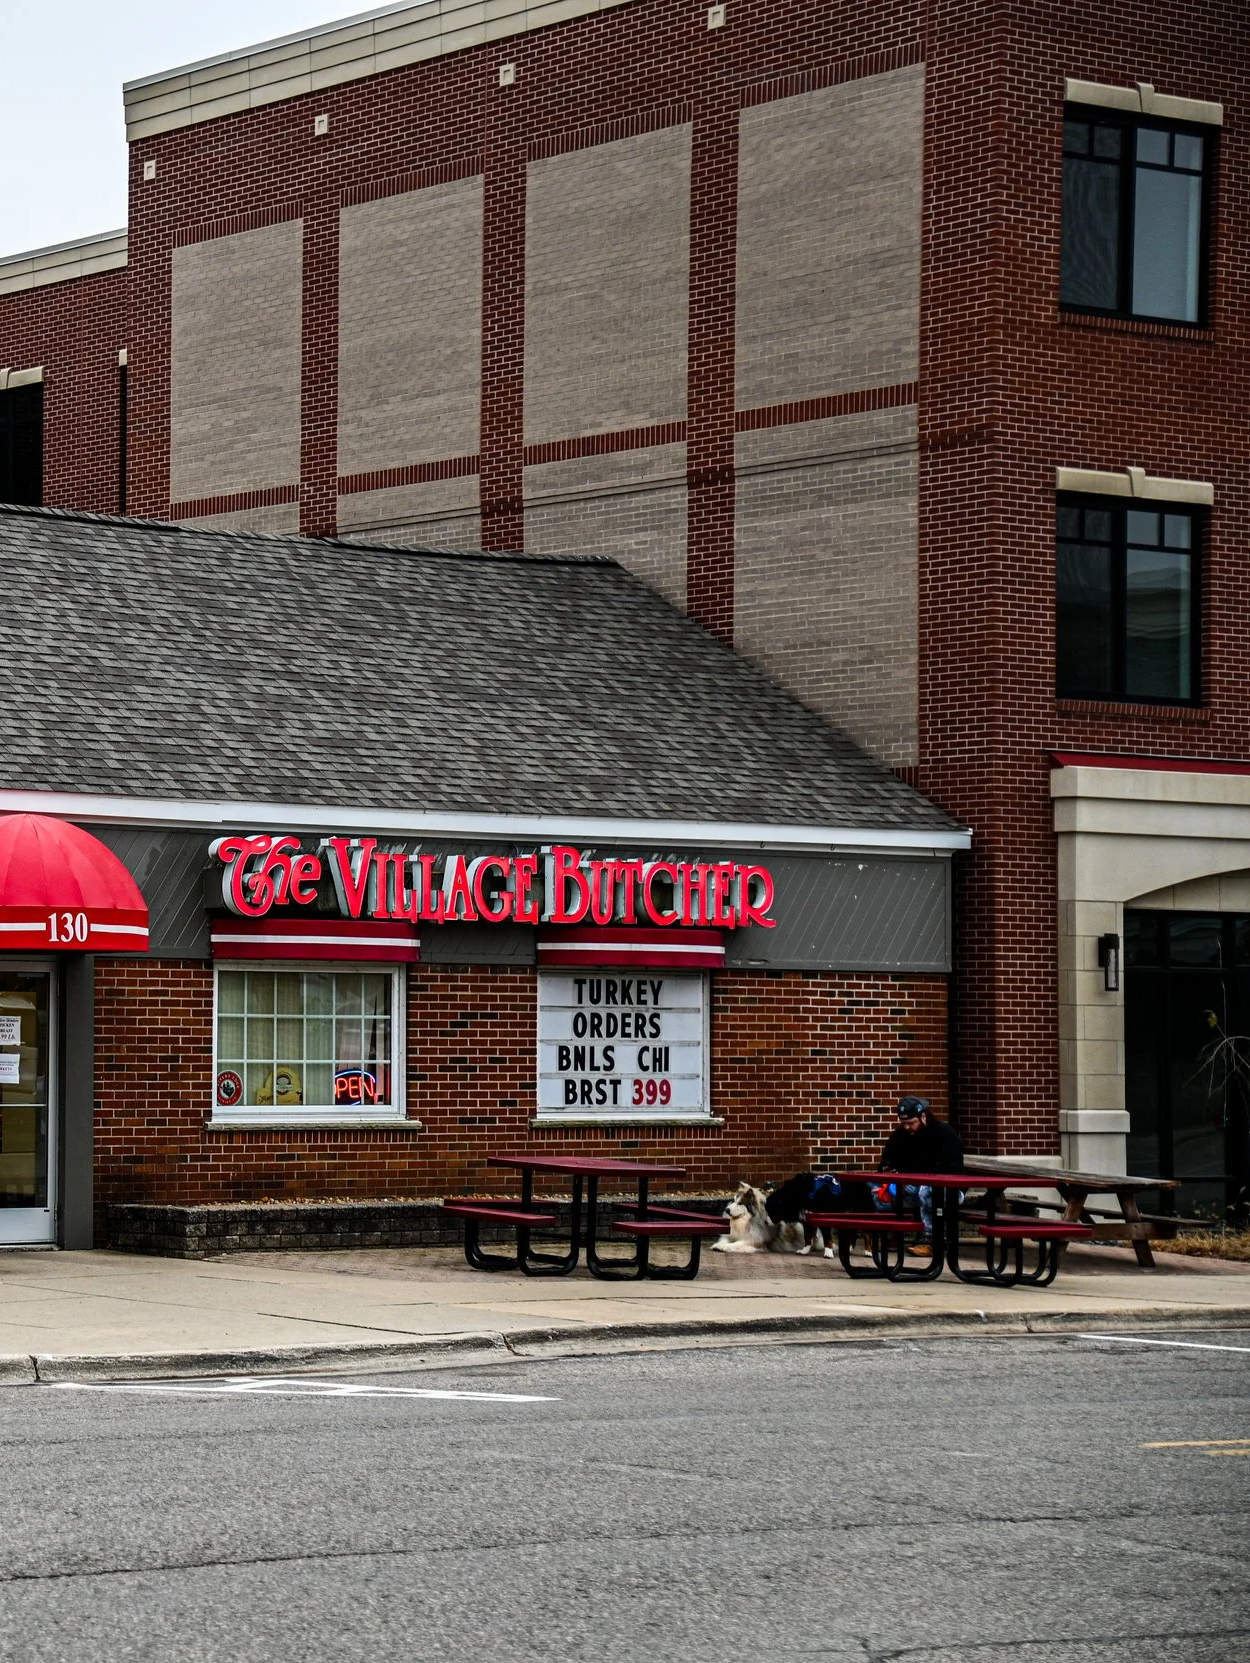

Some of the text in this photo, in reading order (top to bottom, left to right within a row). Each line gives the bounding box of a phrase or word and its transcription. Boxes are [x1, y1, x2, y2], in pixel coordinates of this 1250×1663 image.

[212, 834, 778, 929] The VILLAGE BUTCHER
[48, 912, 88, 942] 130
[573, 979, 663, 1006] TURKEY
[572, 1012, 661, 1039] ORDERS
[558, 1045, 670, 1073] BNLS CHI
[334, 1076, 374, 1099] PEN
[564, 1079, 671, 1105] BRST 399
